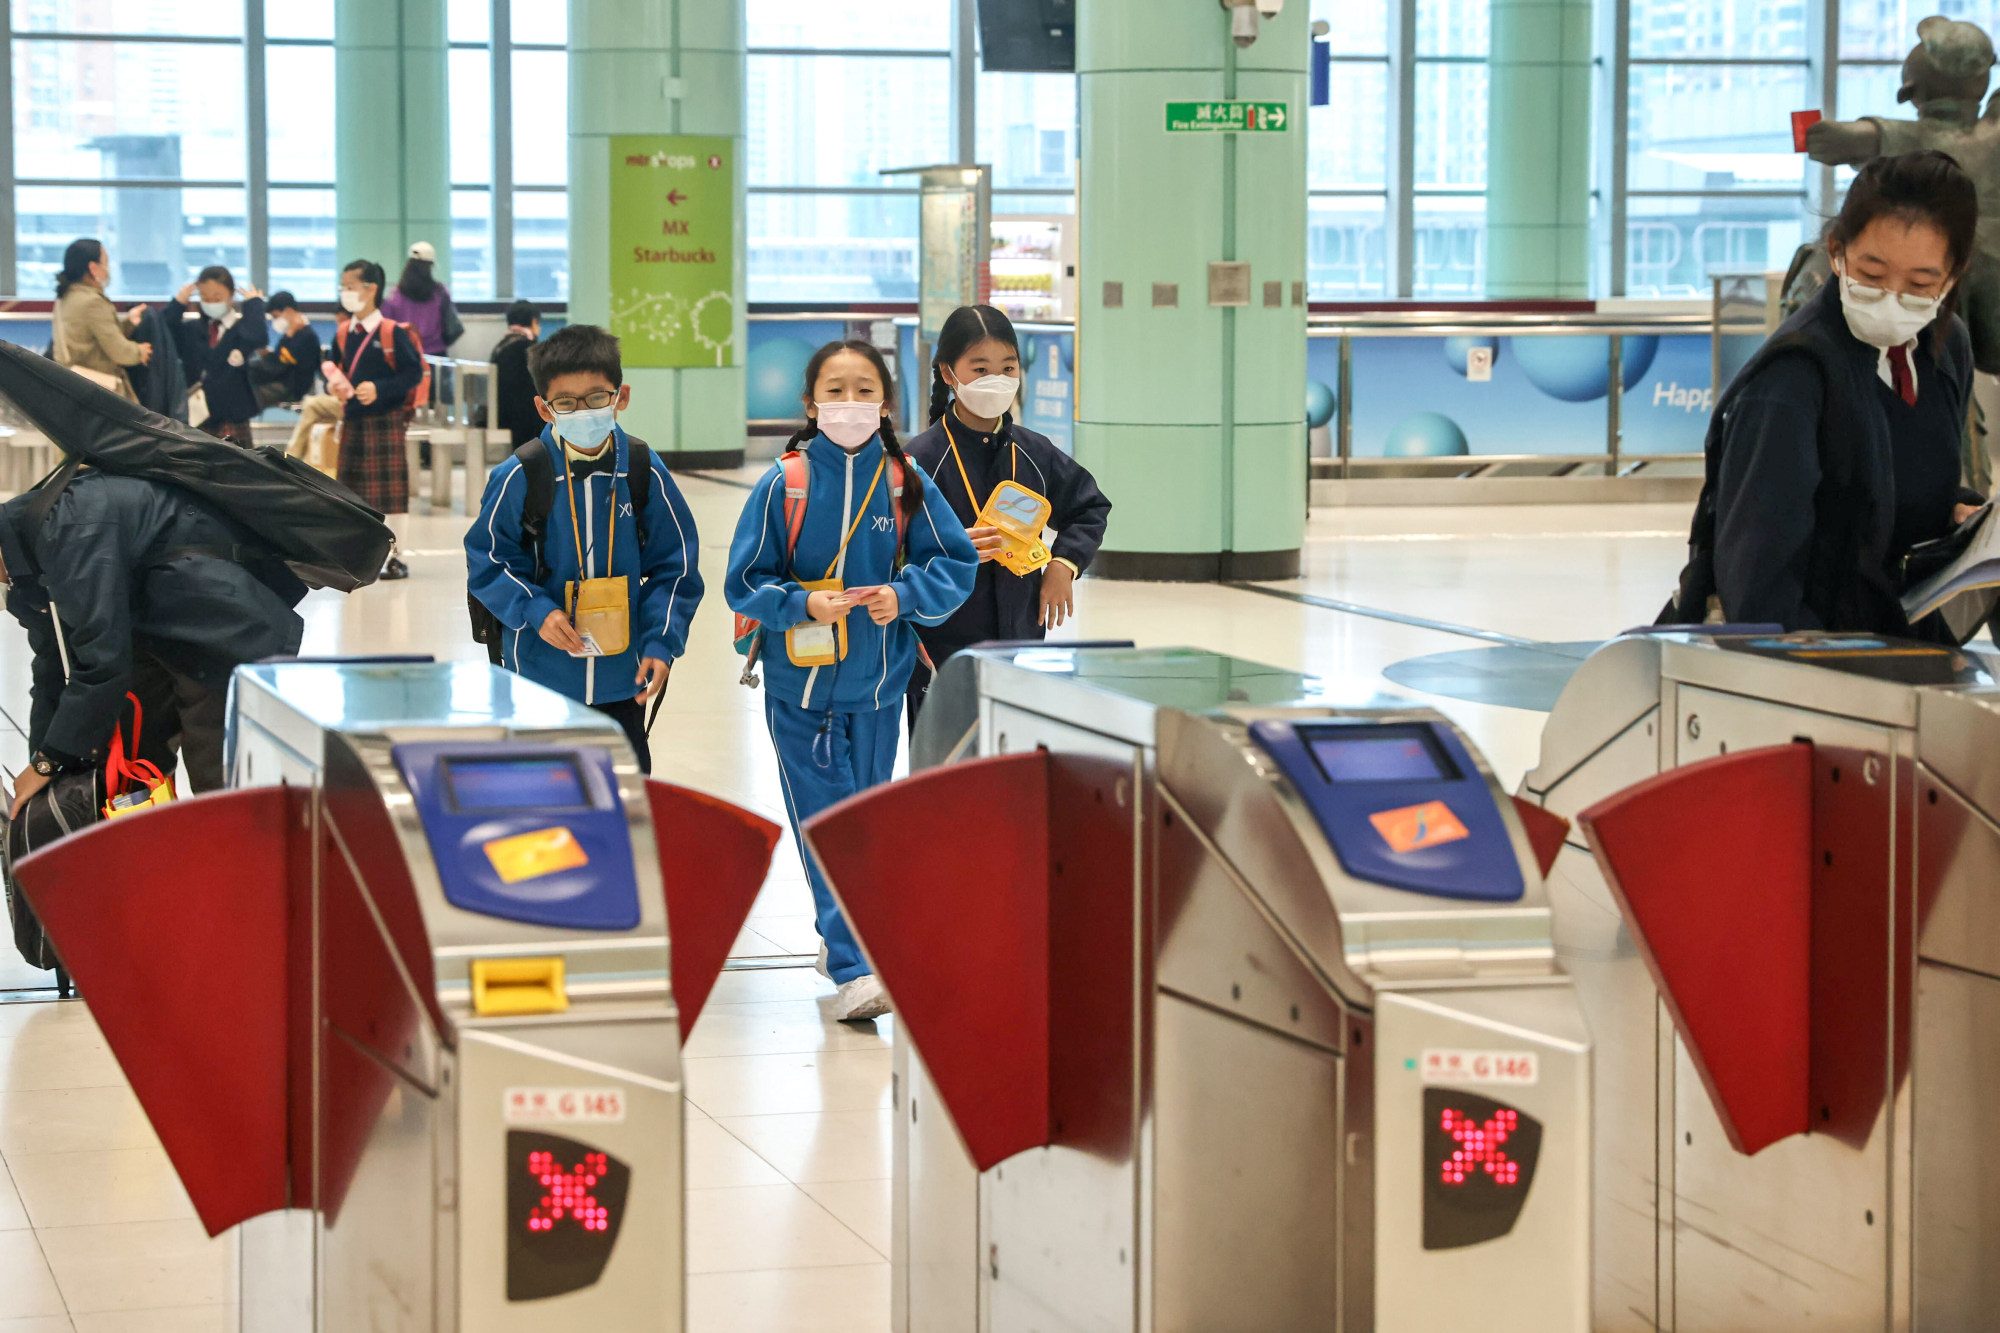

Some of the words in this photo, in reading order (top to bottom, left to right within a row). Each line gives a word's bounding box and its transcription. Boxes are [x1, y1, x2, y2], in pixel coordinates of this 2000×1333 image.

[1172, 120, 1189, 130] Fire
[1190, 120, 1244, 131] Extinguisher
[662, 219, 690, 236] MX
[633, 247, 716, 264] Starbucks
[1653, 381, 1712, 413] Happ
[1472, 1056, 1490, 1077] G
[1496, 1057, 1531, 1078] 146
[558, 1093, 576, 1115] G
